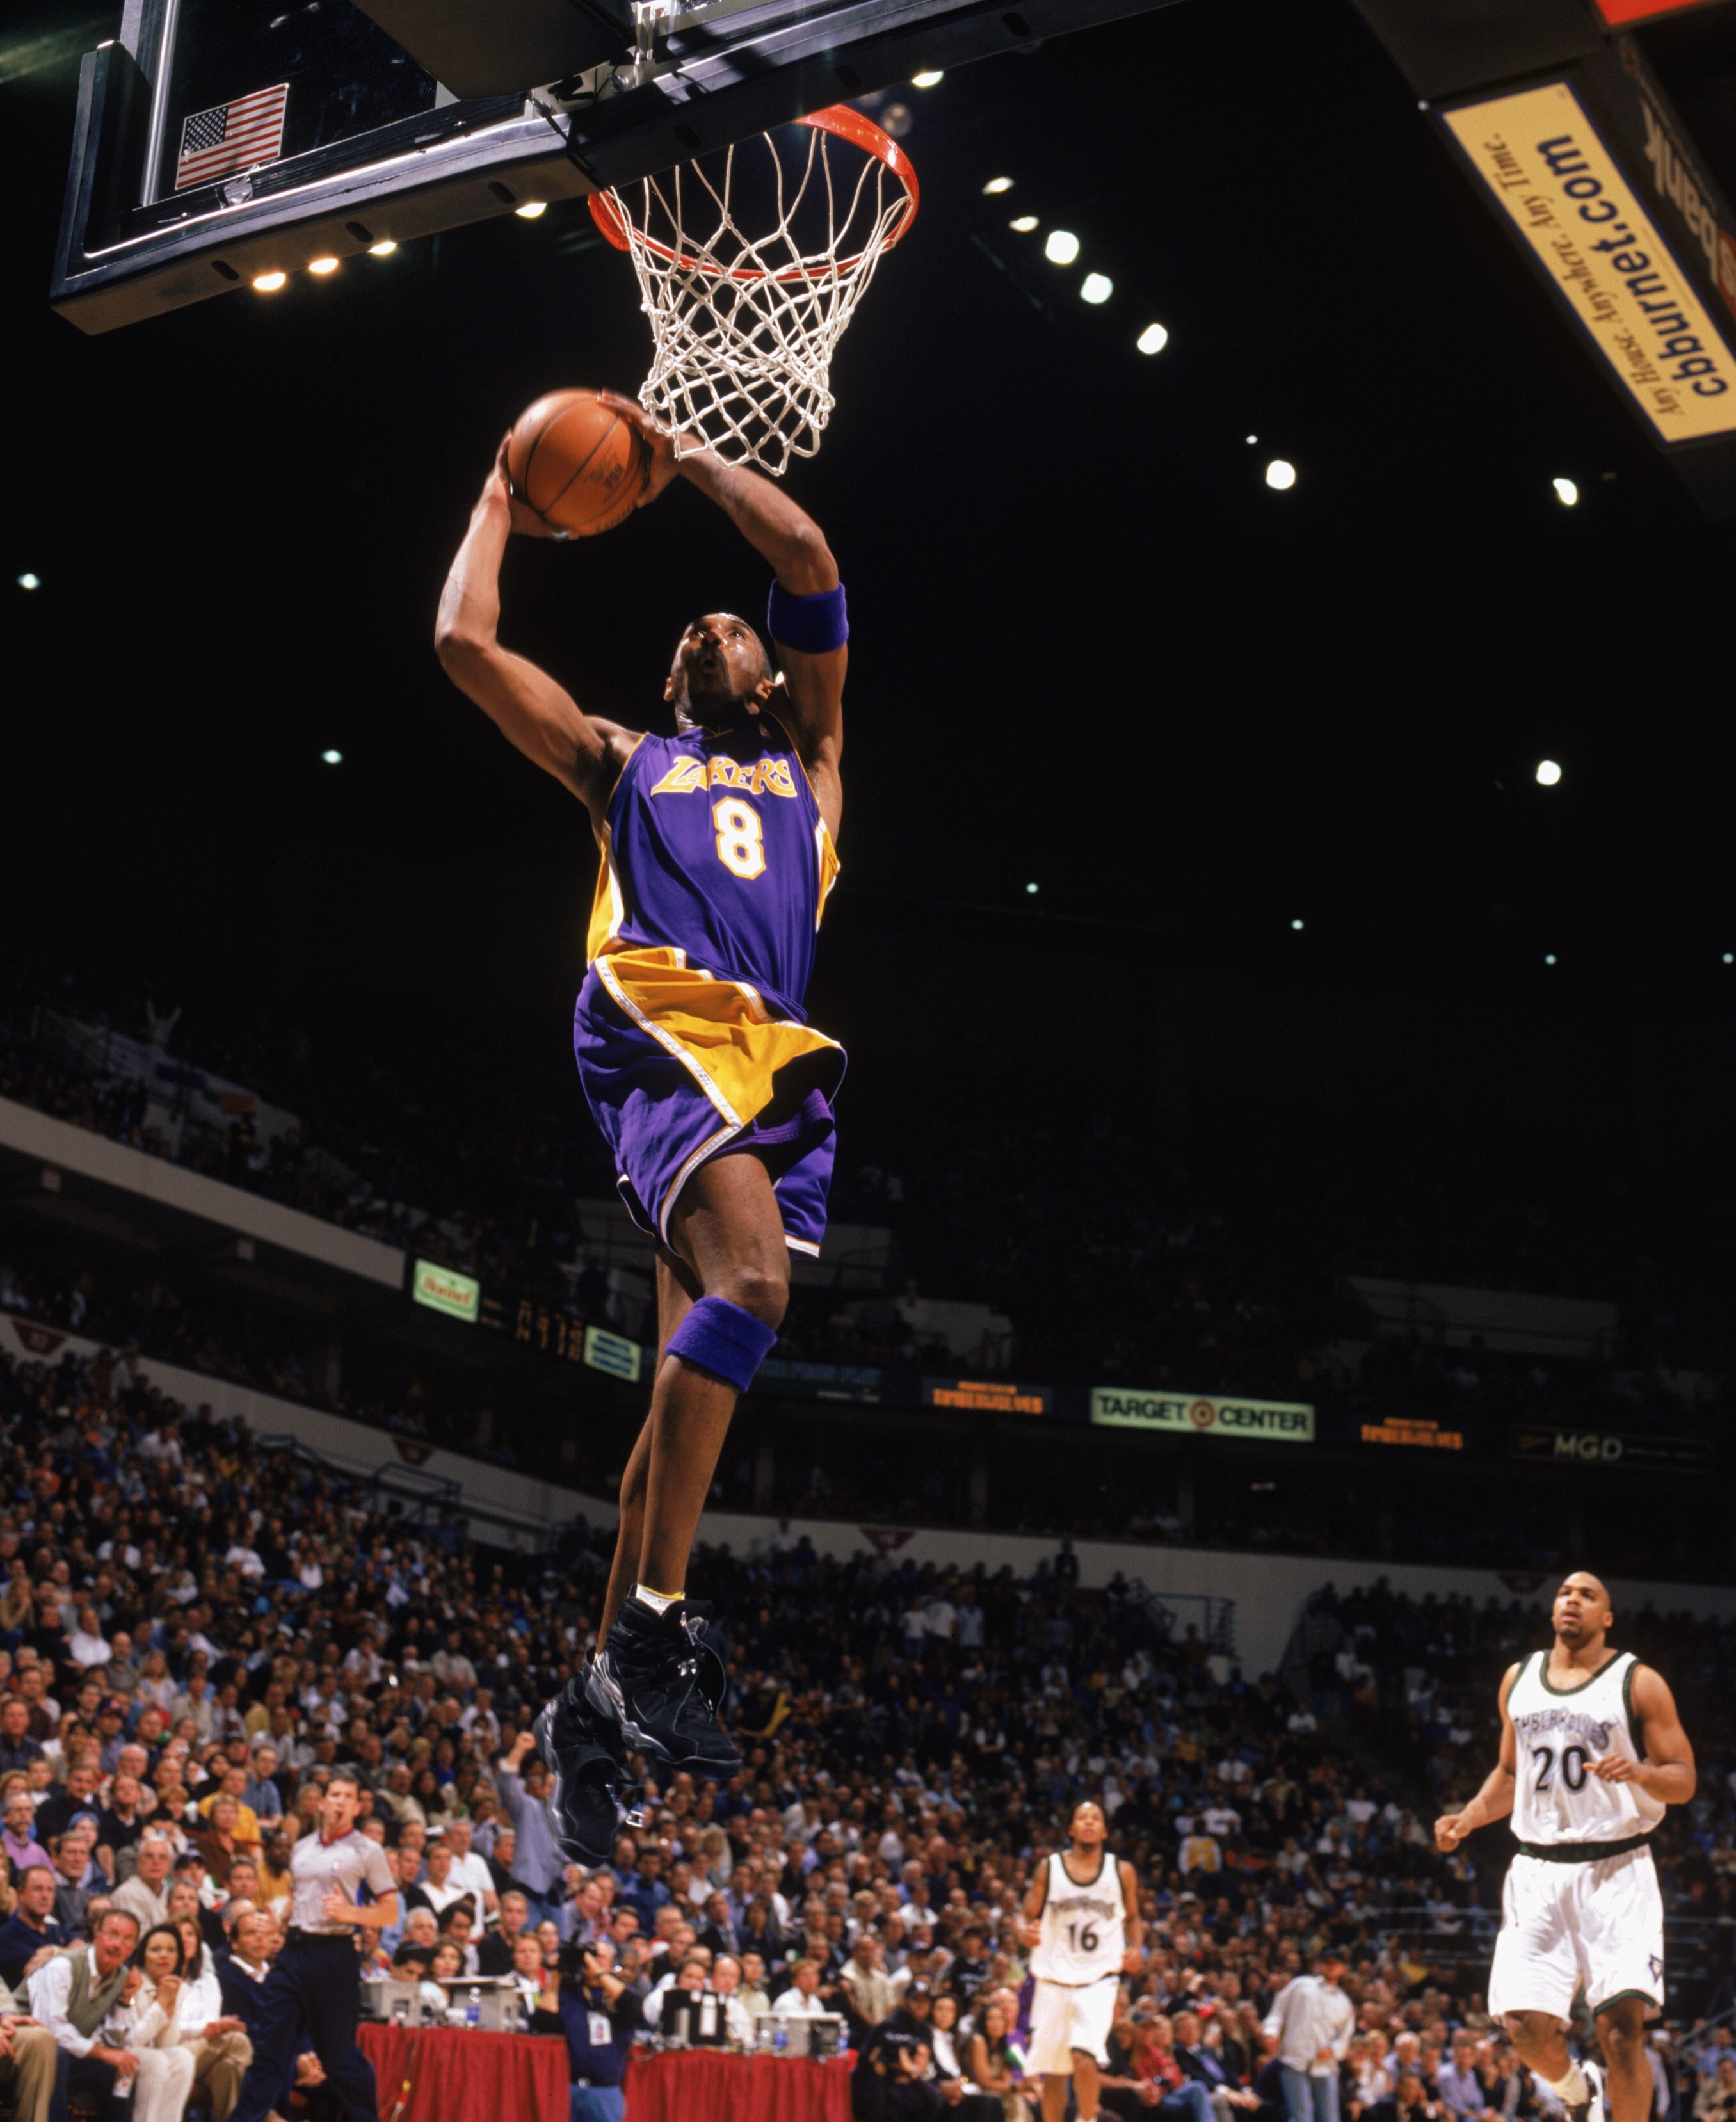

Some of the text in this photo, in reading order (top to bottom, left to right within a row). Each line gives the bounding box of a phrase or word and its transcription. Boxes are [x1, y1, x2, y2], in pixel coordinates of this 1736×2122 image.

[1483, 133, 1687, 416] Any House. Anywhere. Any Time.
[1537, 135, 1729, 397] cbburnet.com
[650, 755, 798, 798] LAKERS
[712, 796, 767, 880] 8
[1099, 1395, 1308, 1432] TARGET CENTER
[1554, 1432, 1623, 1461] MGD
[1532, 1745, 1588, 1791] 20
[1068, 1921, 1099, 1952] 16
